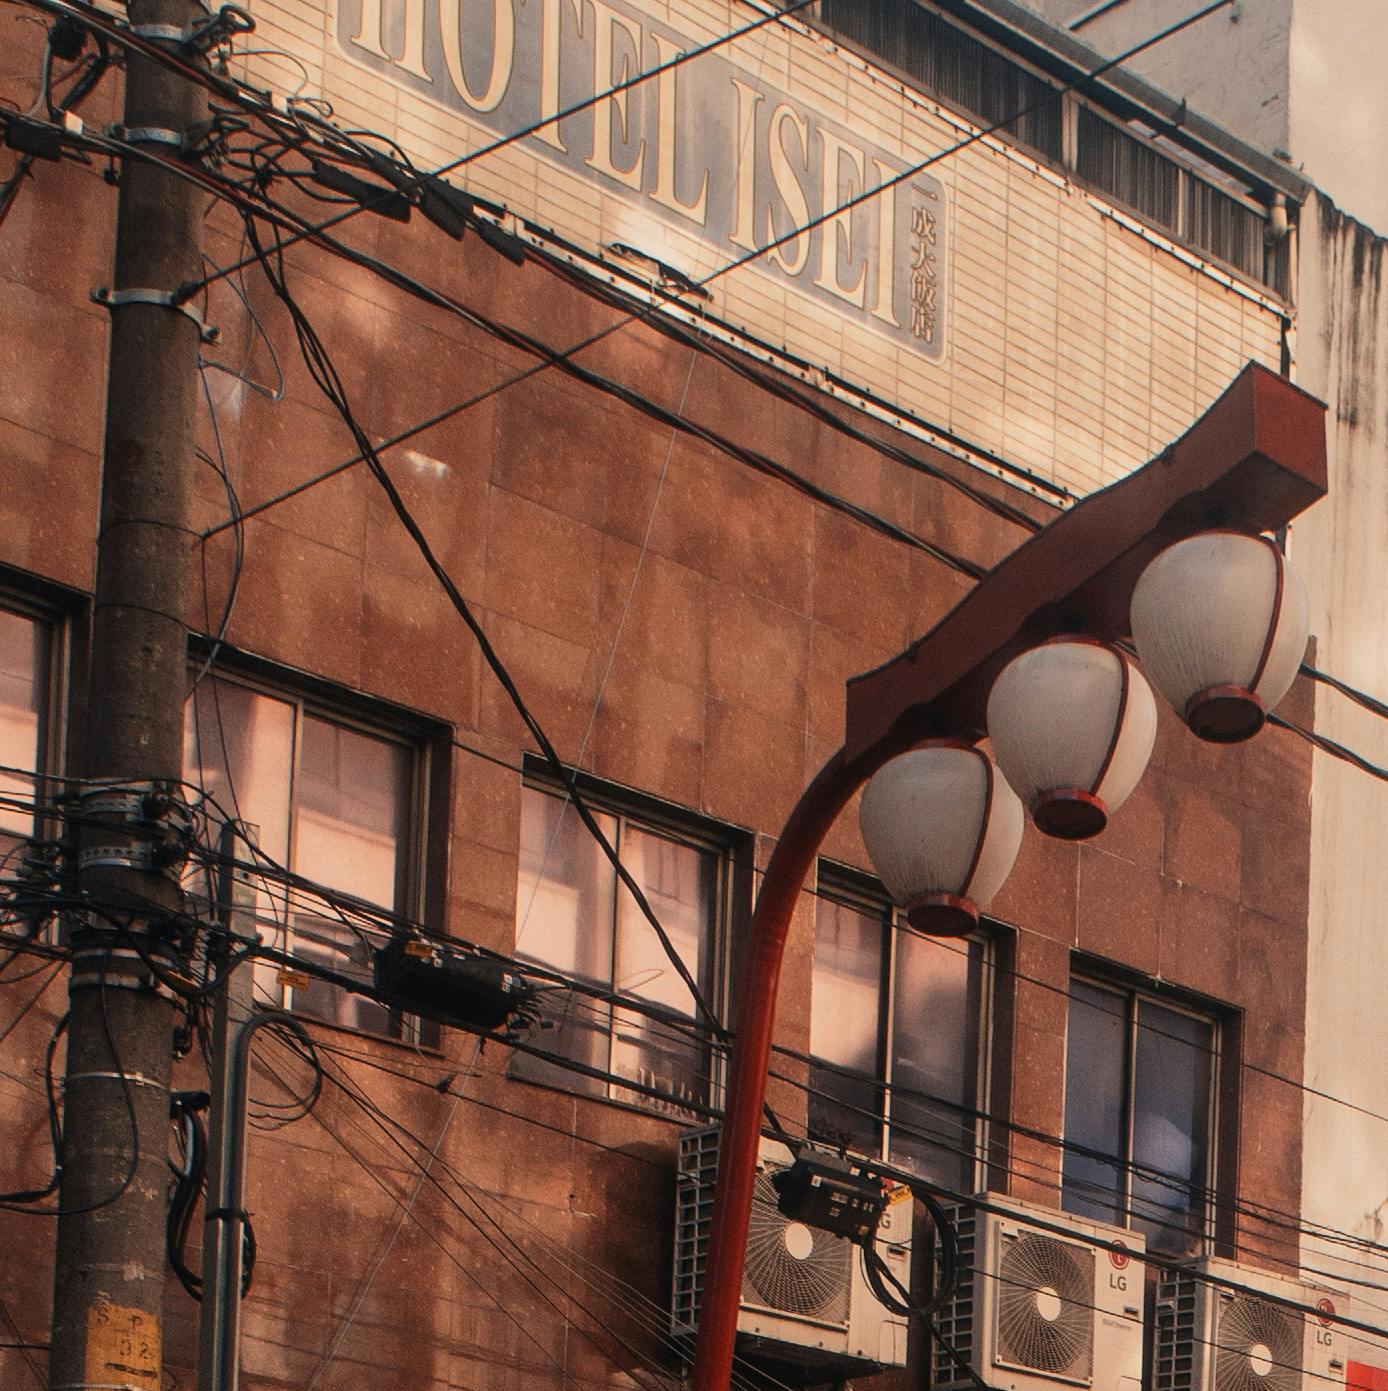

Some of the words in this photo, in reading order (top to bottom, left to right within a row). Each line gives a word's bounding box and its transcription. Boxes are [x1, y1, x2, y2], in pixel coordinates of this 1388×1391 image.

[729, 77, 903, 329] ISEI
[1109, 1272, 1128, 1291] LG
[1317, 1330, 1332, 1346] LG
